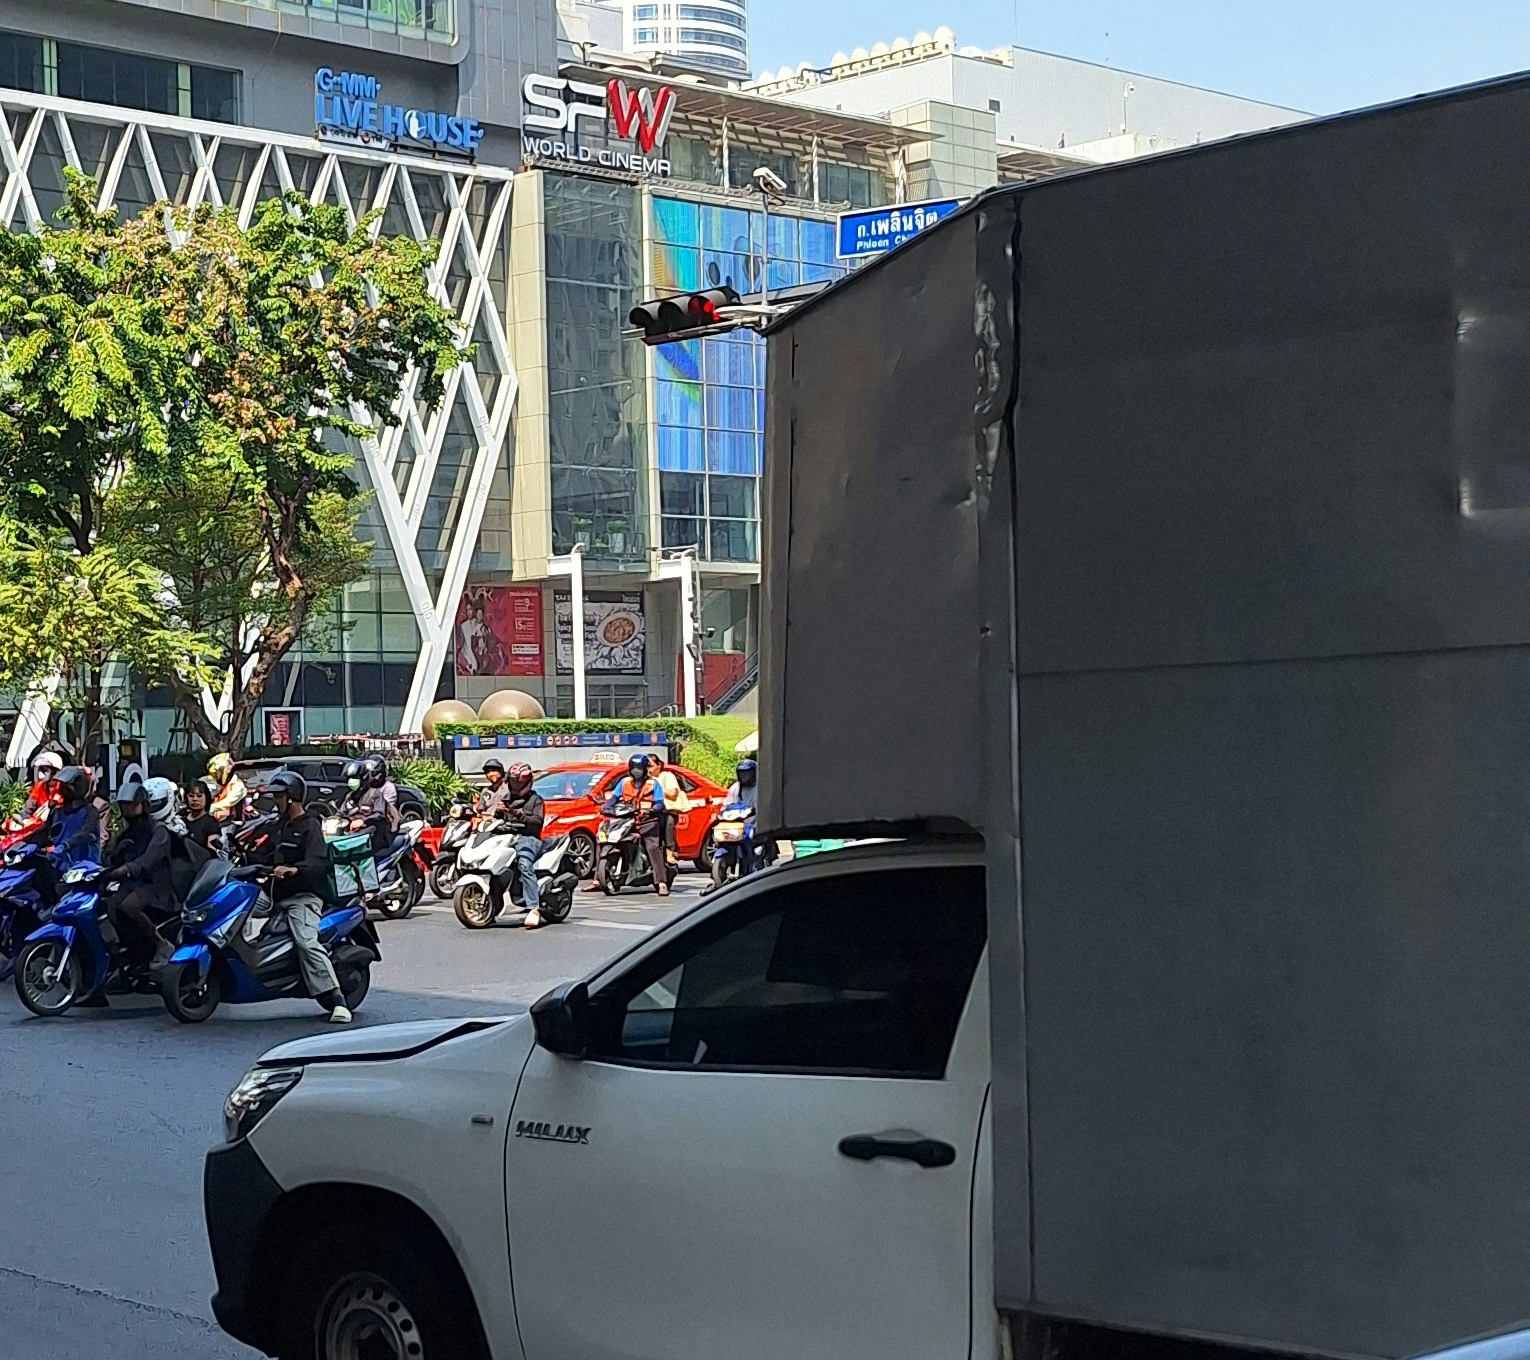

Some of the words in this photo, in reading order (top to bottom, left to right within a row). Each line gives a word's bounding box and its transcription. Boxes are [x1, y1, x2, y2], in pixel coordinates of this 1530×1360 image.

[316, 92, 378, 132] LIVE
[381, 103, 481, 149] HOUSE
[523, 136, 592, 161] WORLD
[597, 148, 671, 176] CINEMA
[856, 239, 890, 252] Phloen
[515, 1120, 592, 1145] HILUX
